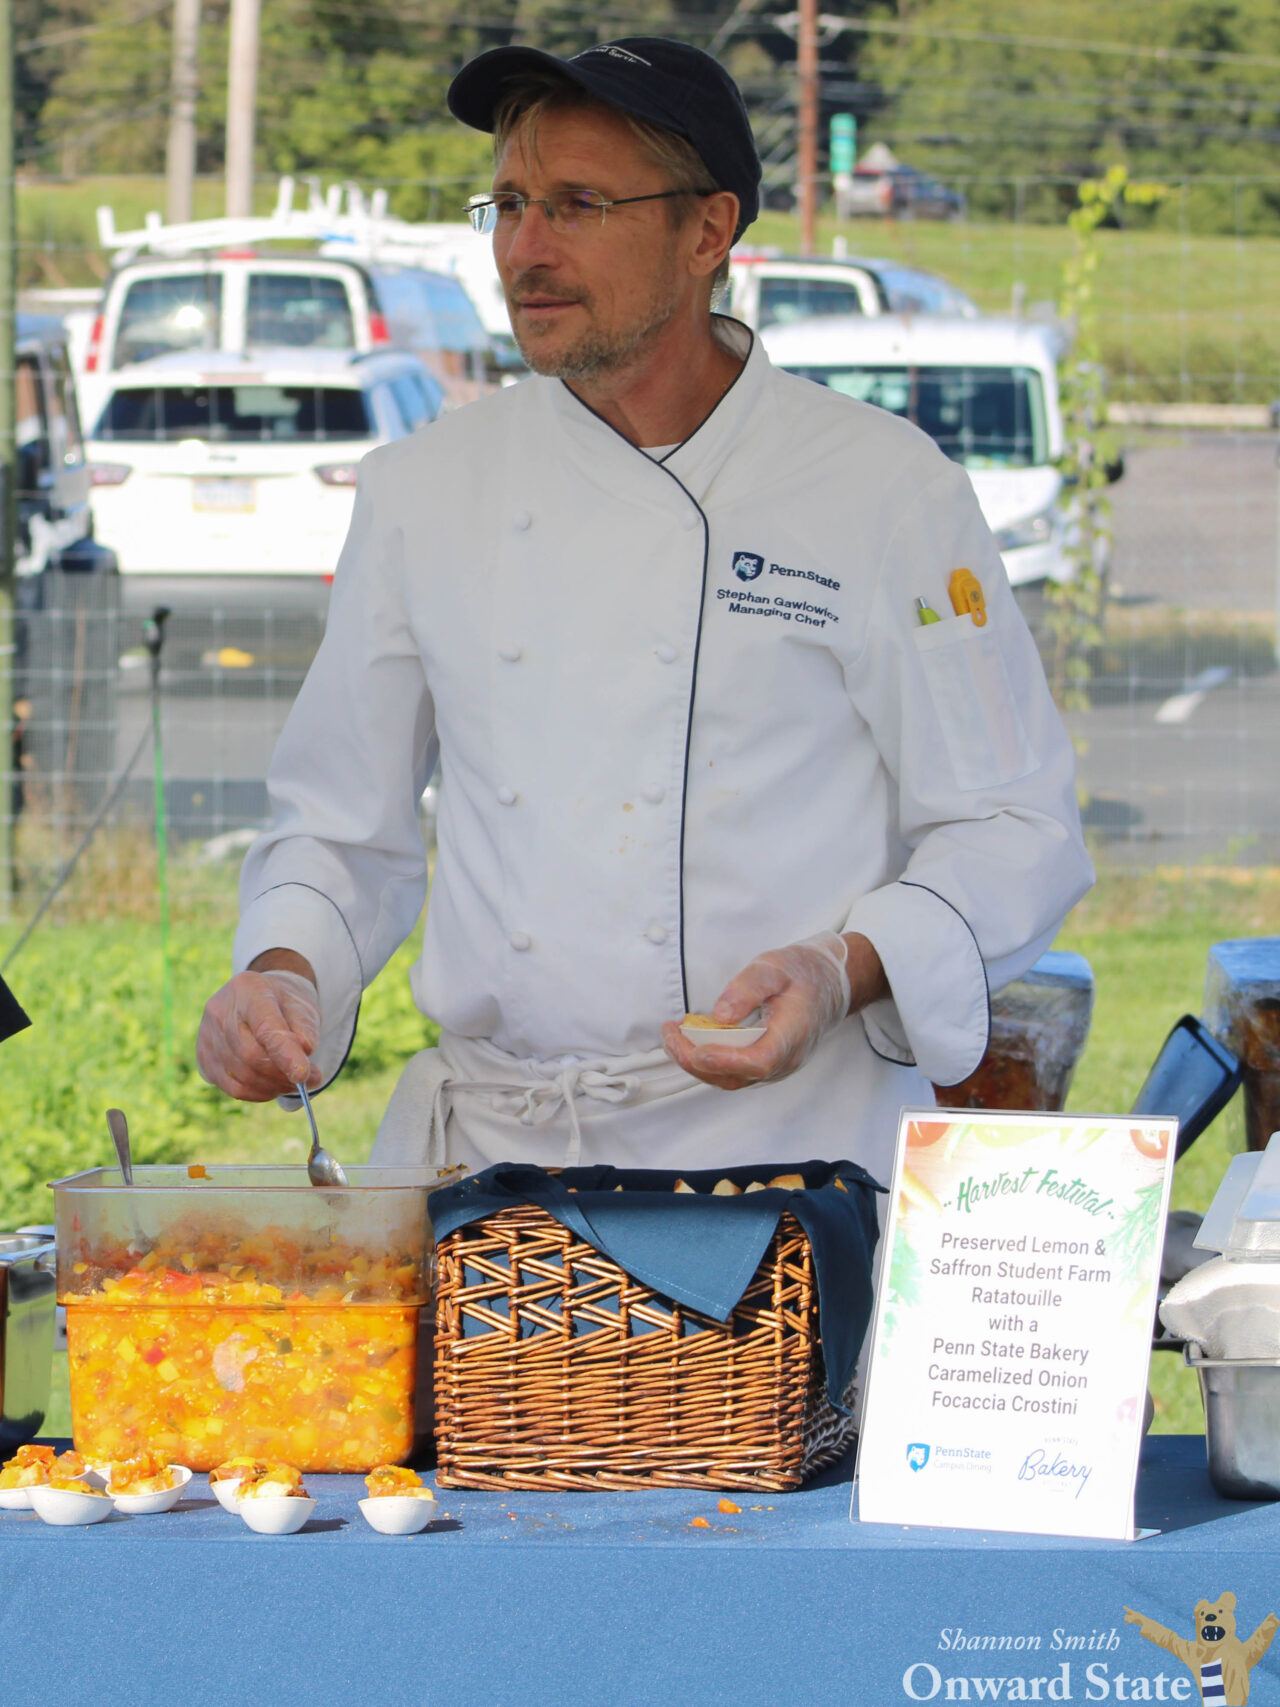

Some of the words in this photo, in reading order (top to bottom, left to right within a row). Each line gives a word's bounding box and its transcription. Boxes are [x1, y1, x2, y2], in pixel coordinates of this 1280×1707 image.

[769, 564, 841, 591] PennState
[716, 588, 770, 604] Stephan
[773, 596, 840, 623] Gawlowicz
[728, 602, 791, 620] Managing
[794, 613, 826, 628] Chef
[957, 1167, 1039, 1213] Harvest
[1036, 1169, 1114, 1216] Festival
[940, 1232, 1027, 1252] Preserved
[1031, 1236, 1089, 1255] Lemon
[1094, 1239, 1107, 1256] &
[929, 1258, 992, 1277] Saffron
[997, 1261, 1063, 1280] Student
[1068, 1264, 1111, 1283] Farm
[971, 1287, 1062, 1307] Ratatouille
[988, 1314, 1024, 1332] with
[1029, 1319, 1038, 1333] a
[932, 1338, 975, 1355] Penn
[980, 1340, 1025, 1358] State
[1030, 1343, 1089, 1366] Bakery
[928, 1364, 1033, 1385] Caramelized
[1038, 1370, 1088, 1389] Onion
[932, 1391, 1006, 1411] Focaccia
[1011, 1395, 1078, 1415] Crostini
[935, 1446, 991, 1459] PennState
[1018, 1449, 1092, 1500] Bakery
